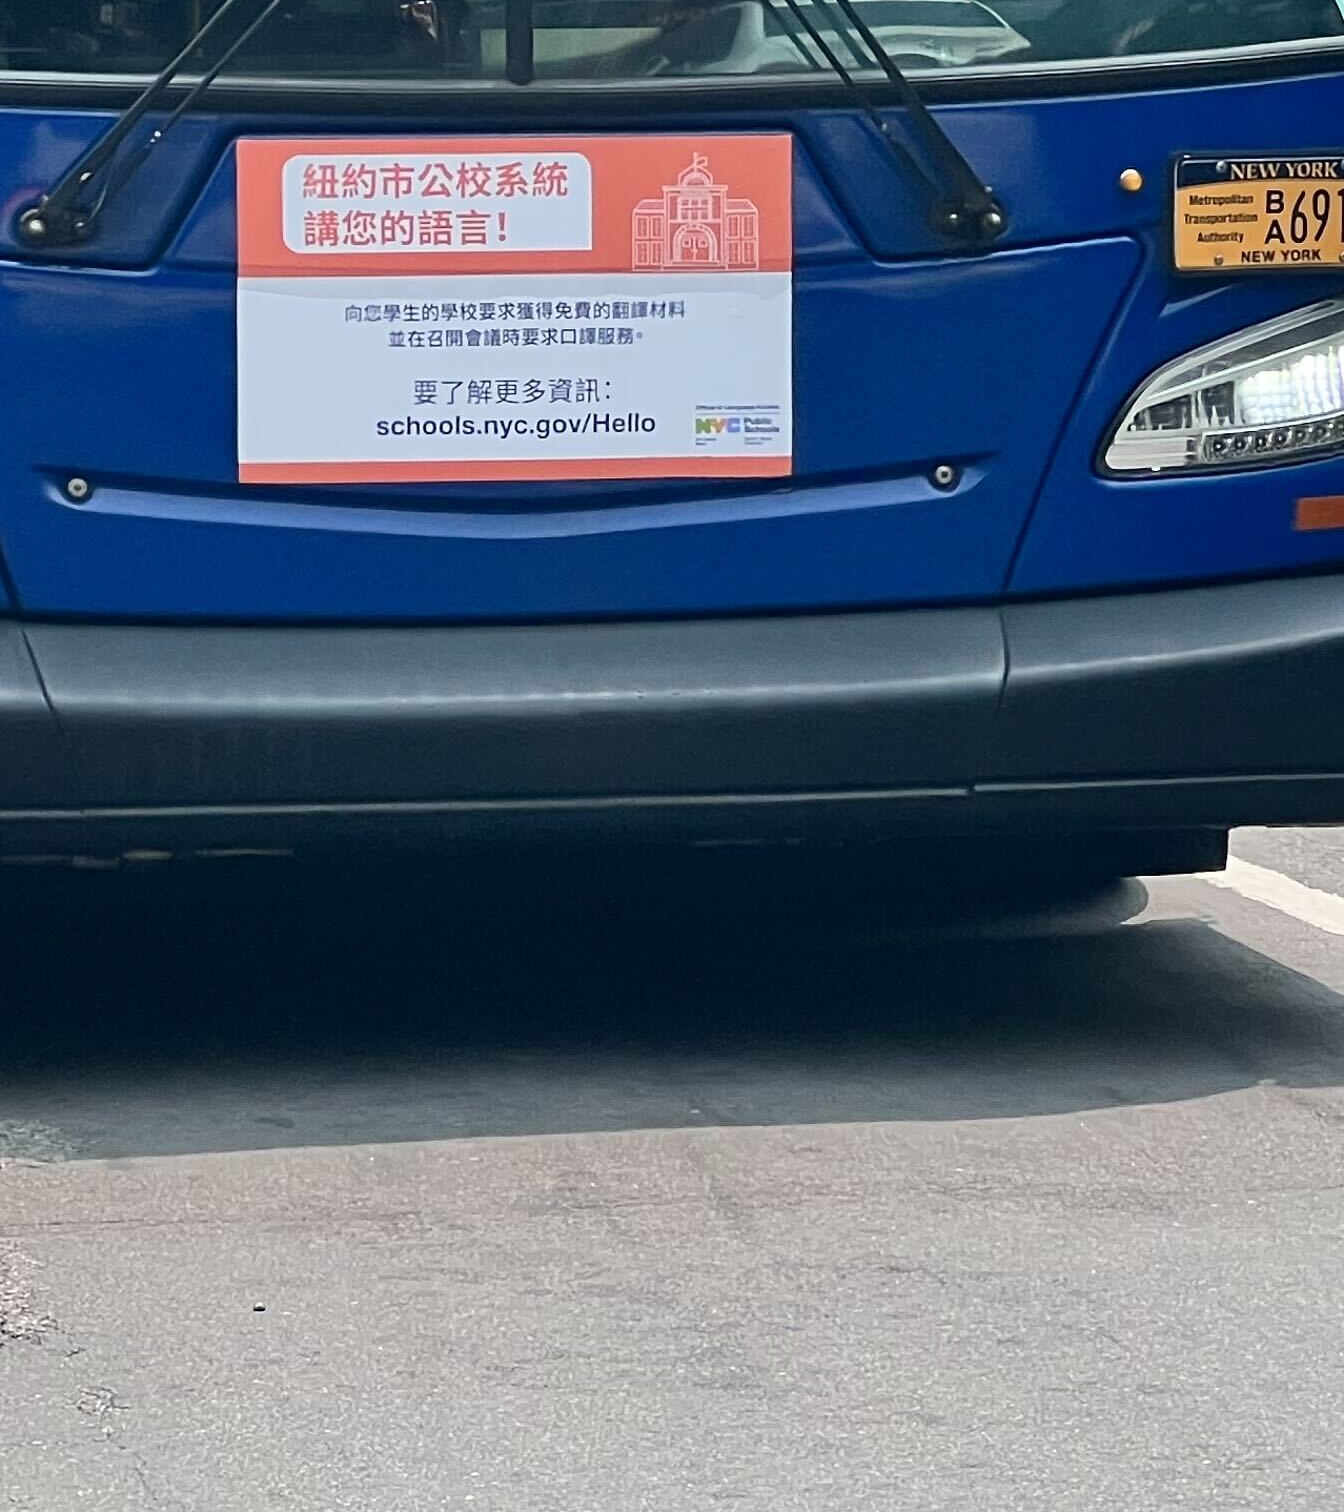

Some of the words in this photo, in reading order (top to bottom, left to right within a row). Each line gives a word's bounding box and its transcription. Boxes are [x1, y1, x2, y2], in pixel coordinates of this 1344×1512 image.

[1230, 161, 1282, 181] NEW
[1285, 160, 1339, 179] YORK
[302, 161, 569, 200] 紐約市公校系統
[1188, 192, 1254, 207] Metropolitan
[1183, 211, 1259, 226] Transportation
[1197, 229, 1245, 245] Authority
[1240, 250, 1277, 264] NEW
[1280, 248, 1323, 263] YORK
[344, 300, 686, 323] 向您學生的學校要求獲得免費的翻譯材料
[375, 412, 657, 440] schools.nyc.gov/Hello
[695, 417, 741, 434] NYC
